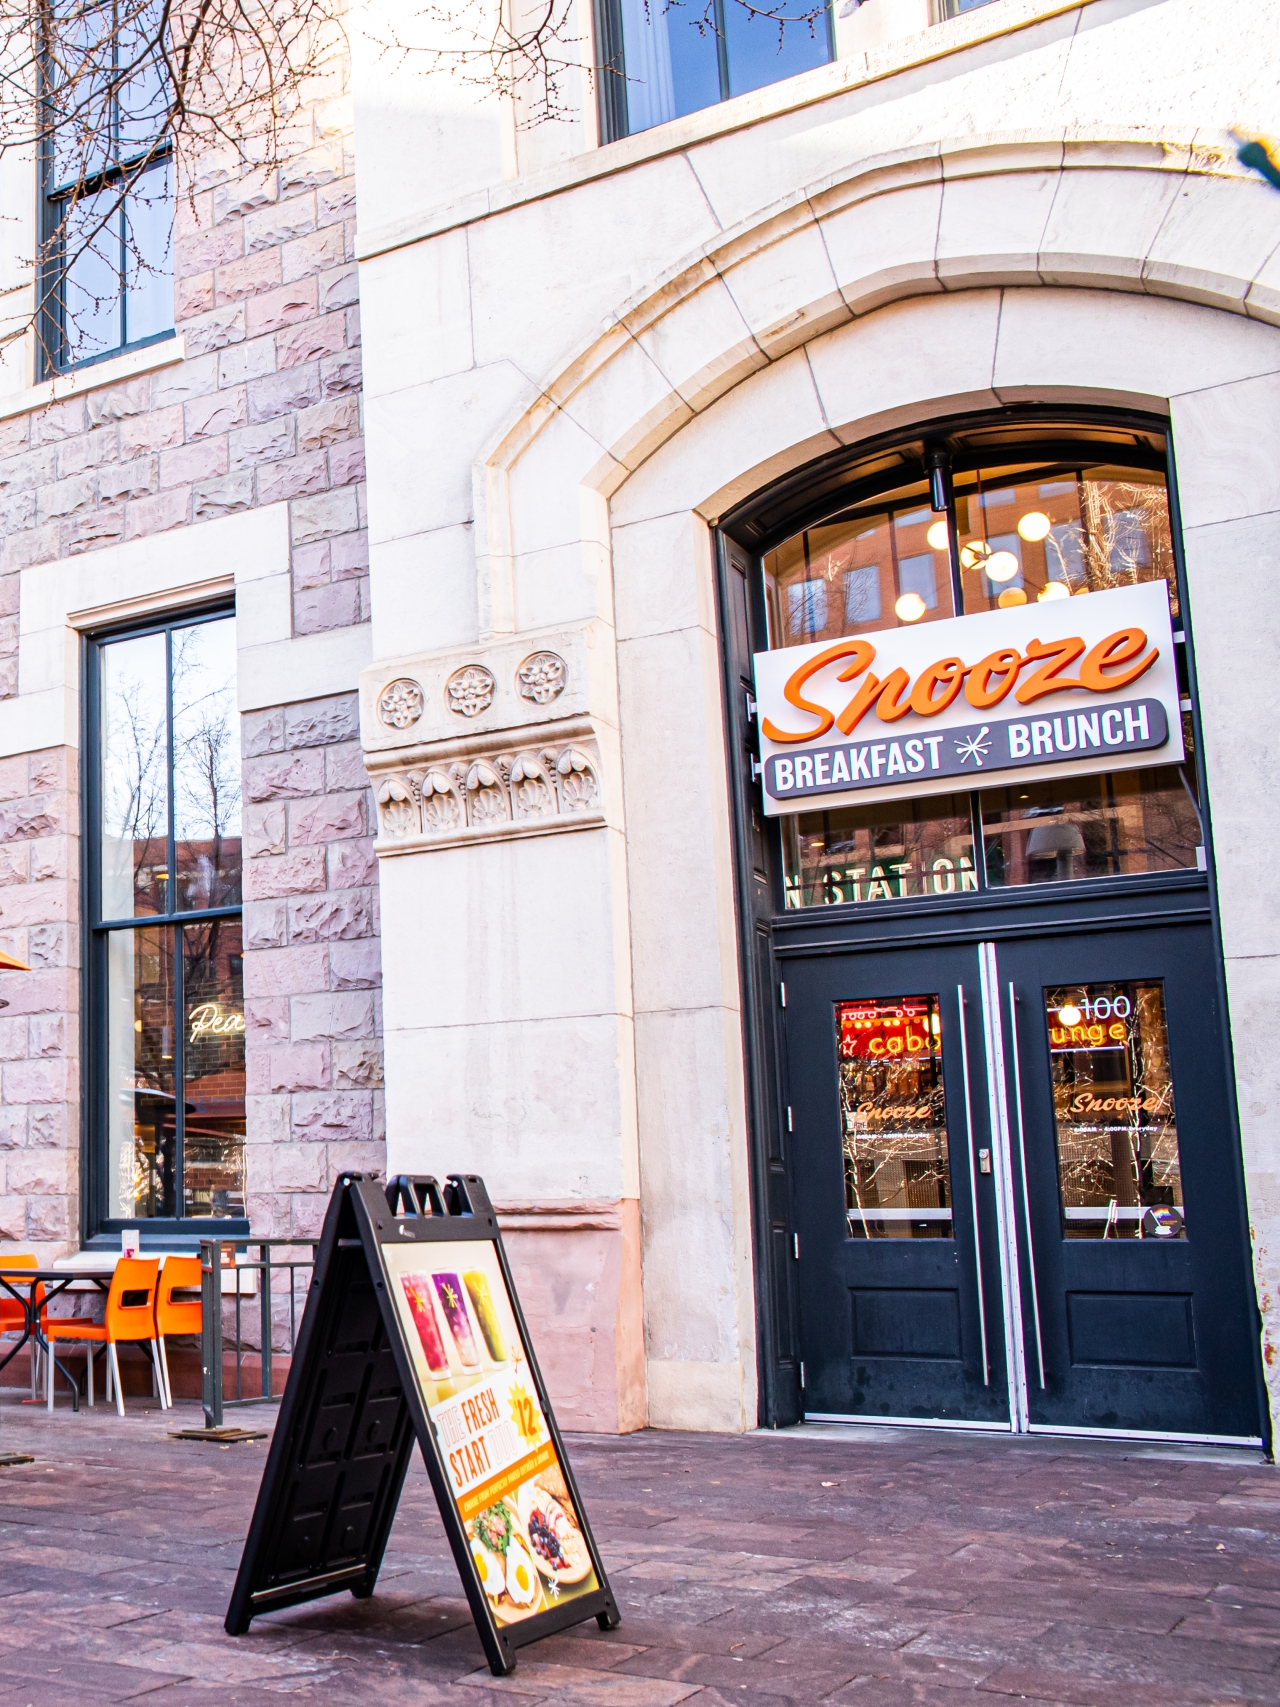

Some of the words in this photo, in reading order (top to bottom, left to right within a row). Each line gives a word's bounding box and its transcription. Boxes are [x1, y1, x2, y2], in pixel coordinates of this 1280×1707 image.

[761, 627, 1160, 744] Snooze
[775, 736, 944, 792] BREAKFAST
[1008, 705, 1150, 759] BRUNCH
[823, 856, 979, 905] STATION
[853, 1101, 932, 1120] Snooze
[1070, 1092, 1160, 1113] Snooze
[438, 1407, 466, 1448] THE
[462, 1389, 500, 1434] FRESH
[450, 1437, 491, 1488] START
[488, 1421, 518, 1465] DUO
